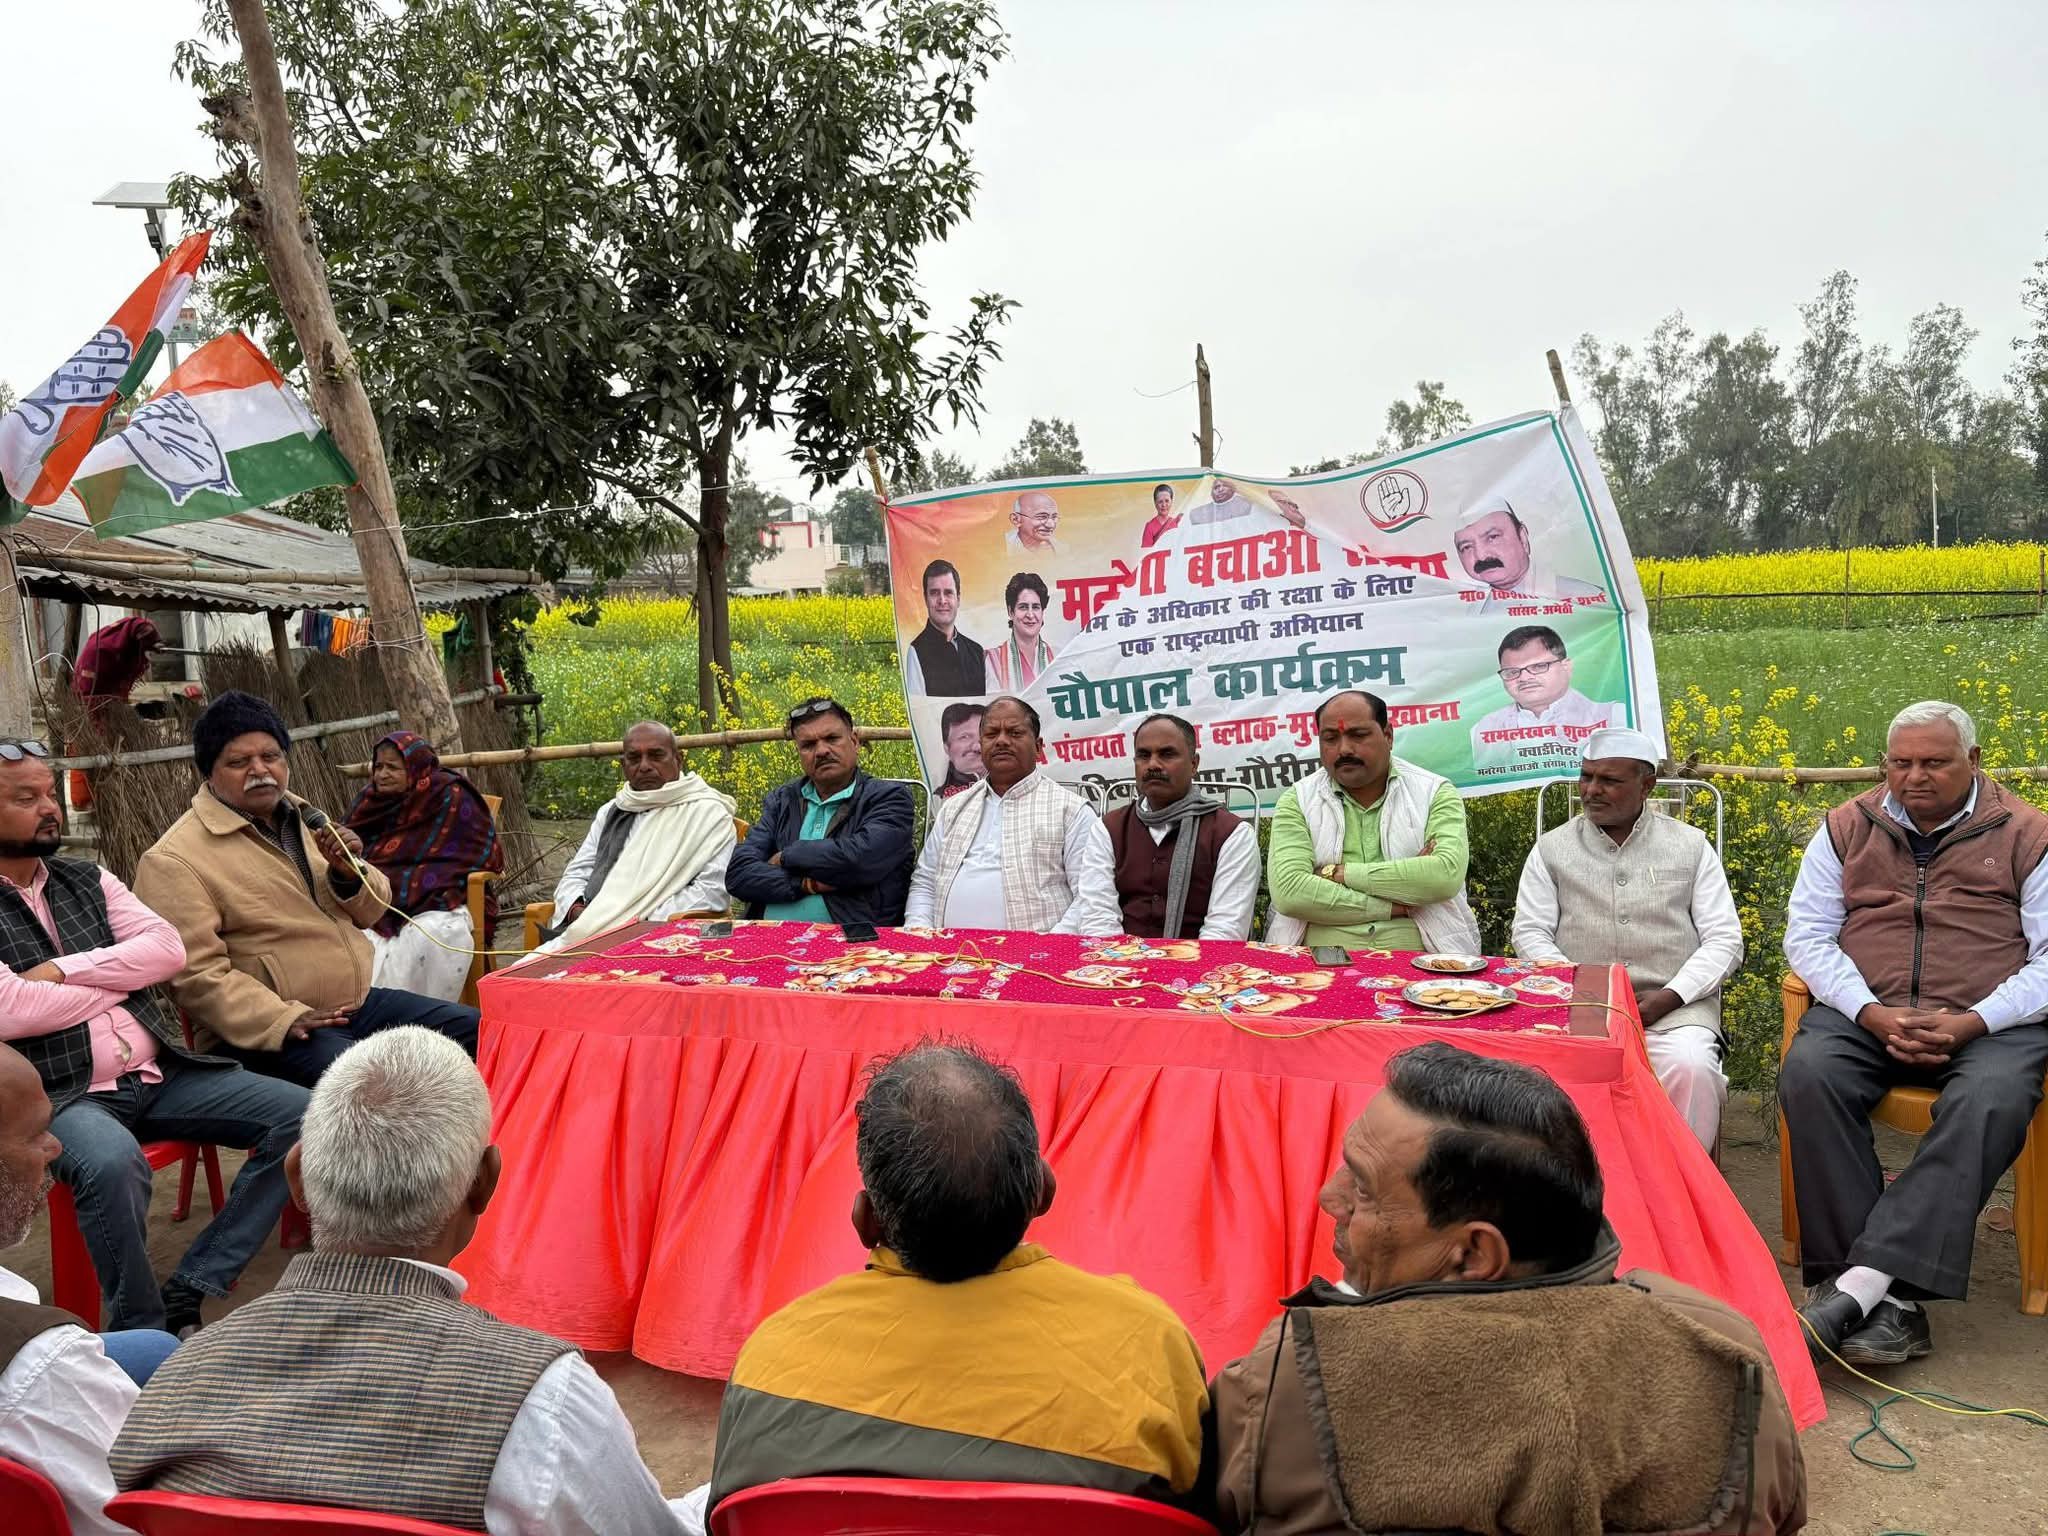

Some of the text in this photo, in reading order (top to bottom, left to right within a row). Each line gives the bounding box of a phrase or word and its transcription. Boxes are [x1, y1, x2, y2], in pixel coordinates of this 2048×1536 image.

[1116, 607, 1139, 628] के
[1147, 597, 1232, 624] अधिकार
[1238, 588, 1271, 610] की
[1279, 584, 1323, 606] रक्षा
[1331, 578, 1357, 600] के
[1364, 574, 1416, 597] लिए
[1118, 612, 1364, 658] एक राष्ट्रव्यापी अभियान
[1047, 642, 1407, 721] चौपाल कार्यक्रम
[1052, 733, 1127, 763] पंचायत
[1480, 724, 1557, 744] रामलखन
